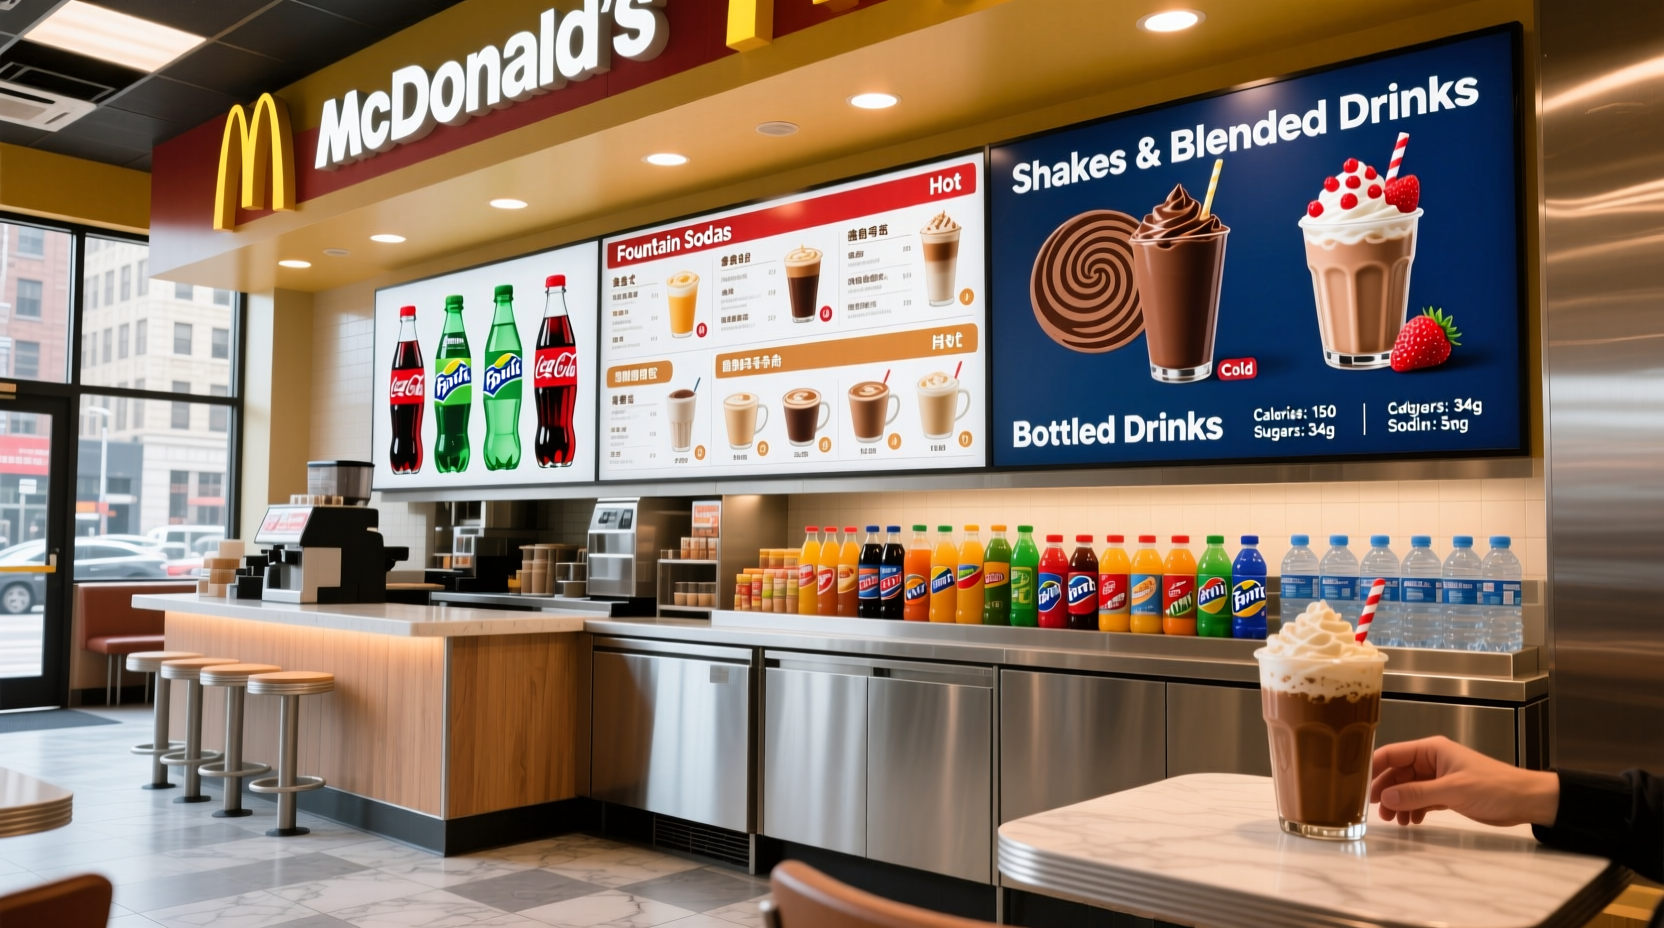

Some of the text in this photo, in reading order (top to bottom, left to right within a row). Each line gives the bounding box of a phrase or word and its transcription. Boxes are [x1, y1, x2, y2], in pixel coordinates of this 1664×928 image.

[315, 0, 656, 170] McDonald's
[1012, 75, 1479, 194] Shakes & Blended Drinks
[929, 172, 962, 195] Hot
[617, 225, 732, 263] Fountain Sodas
[1221, 361, 1253, 377] Cold
[1253, 404, 1337, 422] Calories: 150
[1454, 398, 1482, 416] 34g
[1013, 411, 1224, 448] Bottled Drinks
[1254, 422, 1335, 442] Sugars: 34g
